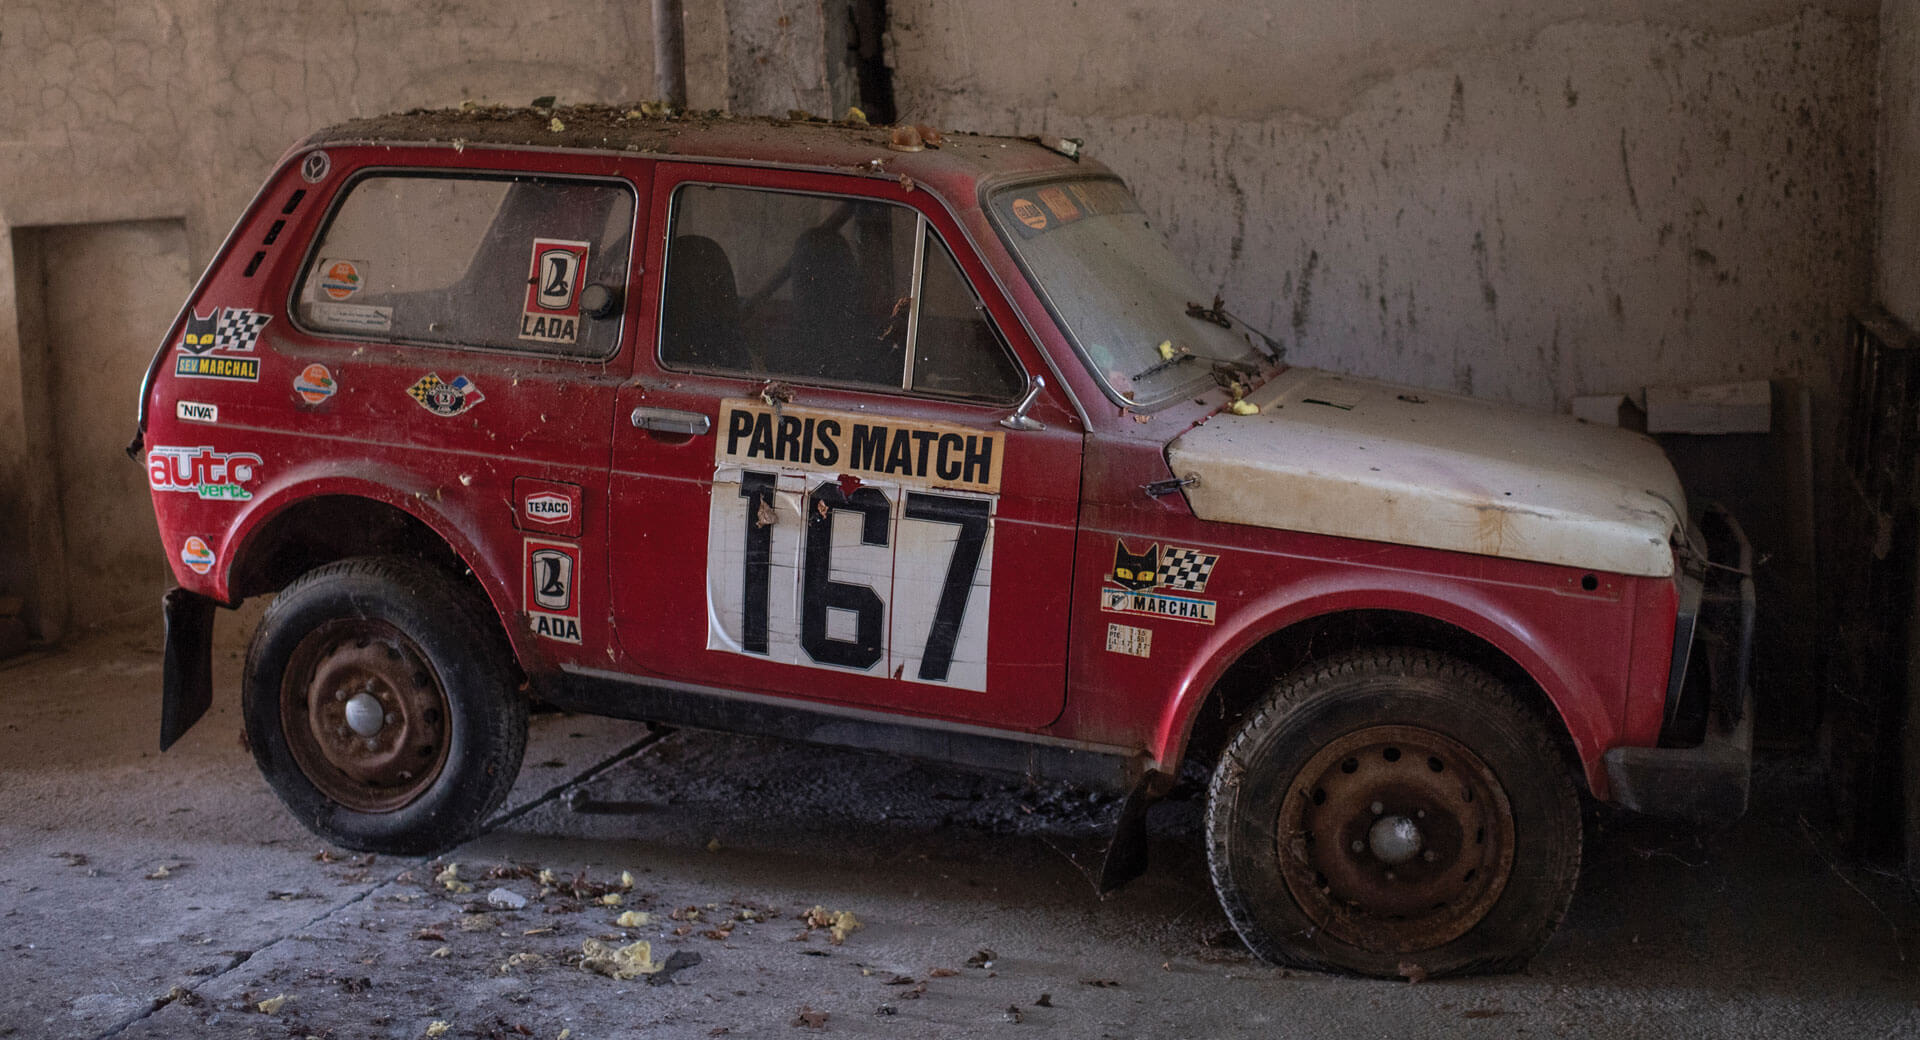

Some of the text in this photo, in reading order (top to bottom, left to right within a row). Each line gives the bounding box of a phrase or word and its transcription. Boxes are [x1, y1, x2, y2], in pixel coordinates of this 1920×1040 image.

[521, 315, 576, 340] LADA
[199, 358, 256, 377] MARCHAL
[727, 409, 994, 485] PARIS MATCH
[150, 450, 260, 488] auto
[199, 483, 252, 498] verte
[528, 501, 569, 514] TEXACO
[738, 468, 994, 684] 167
[1133, 596, 1209, 619] MARCHAL
[536, 615, 581, 640] ADA
